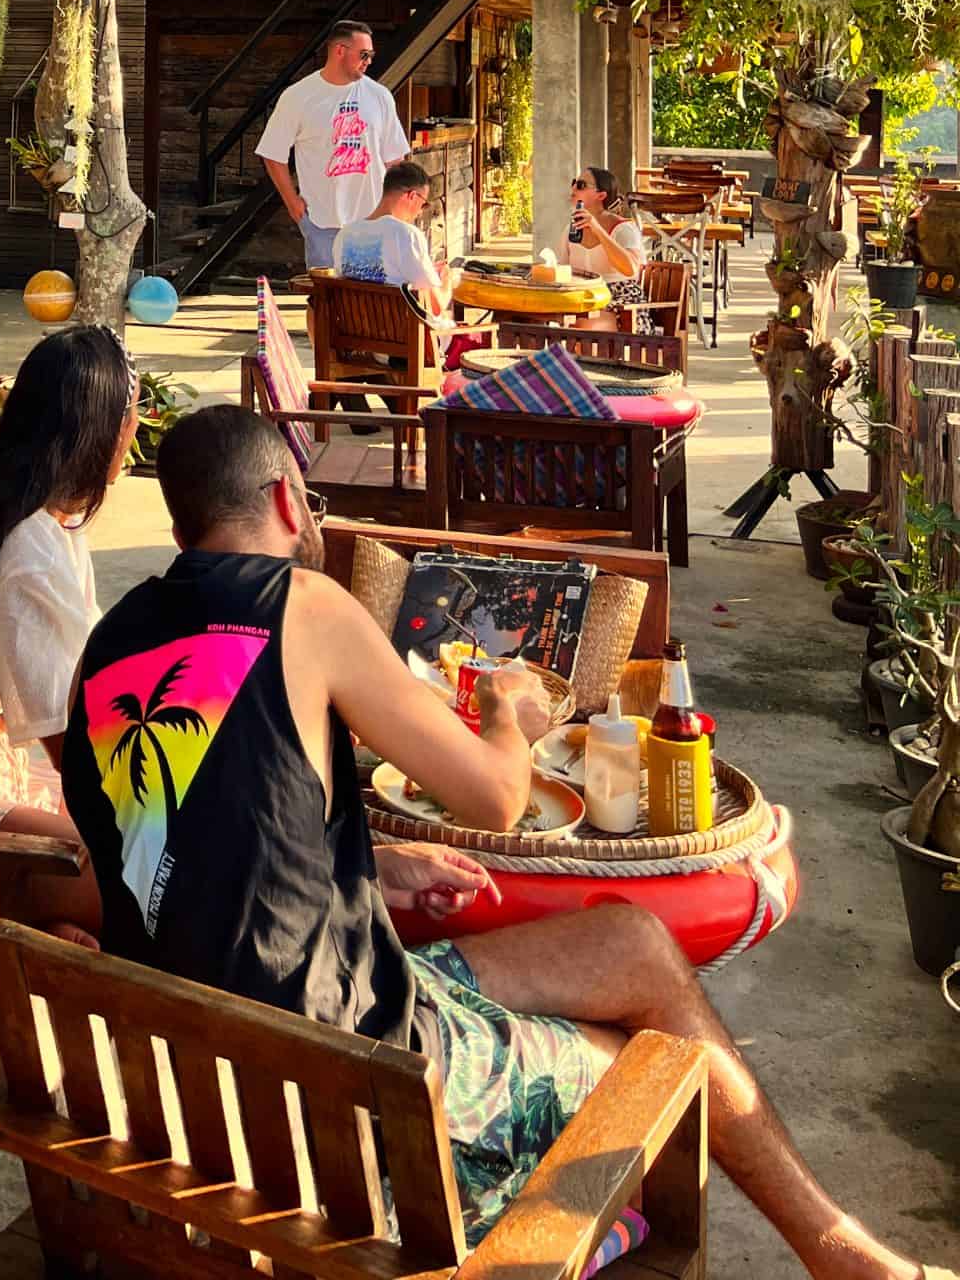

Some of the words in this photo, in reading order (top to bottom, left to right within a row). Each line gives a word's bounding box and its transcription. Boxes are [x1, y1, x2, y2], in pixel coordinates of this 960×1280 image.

[678, 760, 691, 793] 1933
[156, 851, 176, 886] PARTY
[149, 883, 166, 918] MOON
